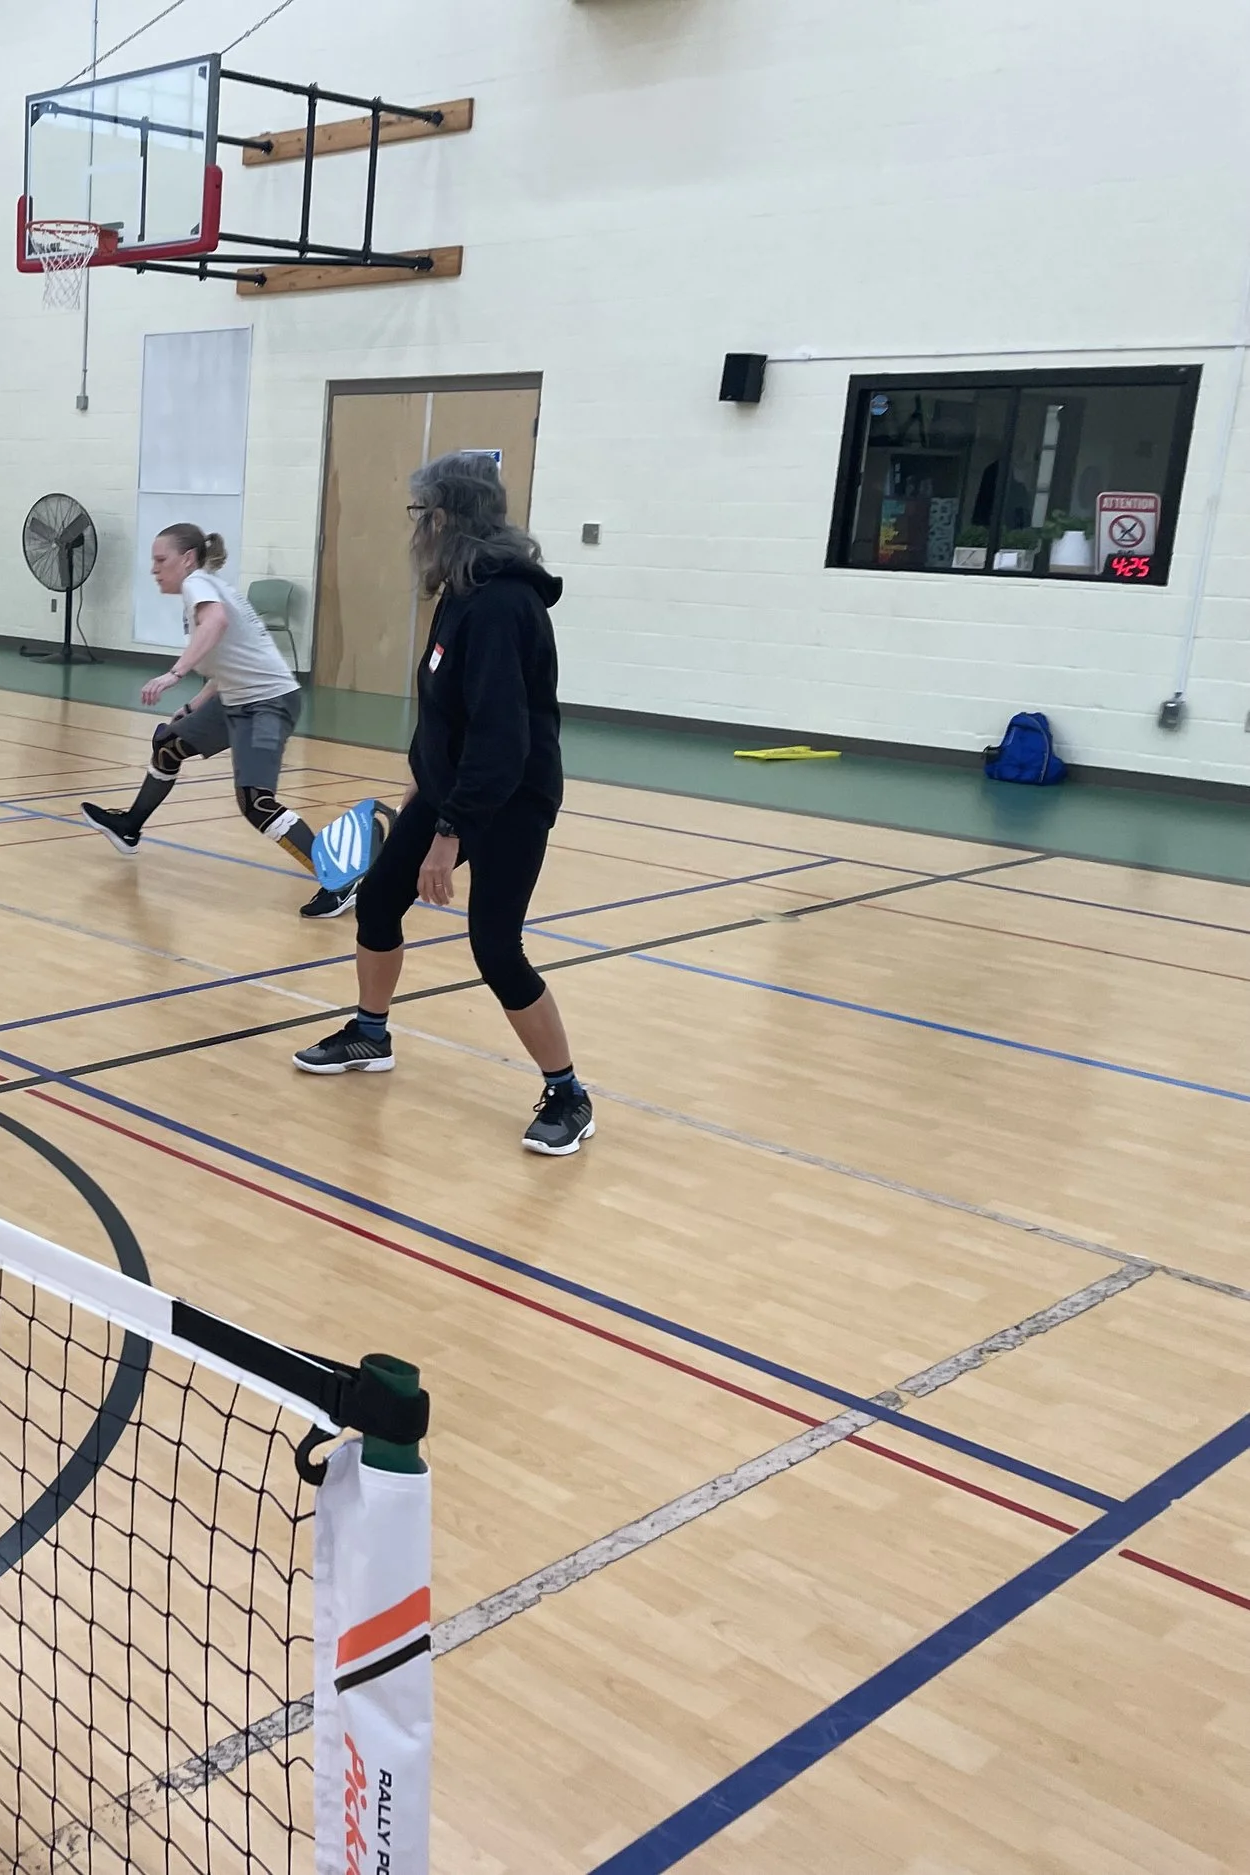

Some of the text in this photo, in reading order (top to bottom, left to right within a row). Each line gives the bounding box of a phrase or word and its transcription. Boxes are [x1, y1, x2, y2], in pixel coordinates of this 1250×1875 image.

[1102, 497, 1156, 510] ATTENTION
[343, 1731, 368, 1875] Pickl
[376, 1768, 393, 1847] RALLY
